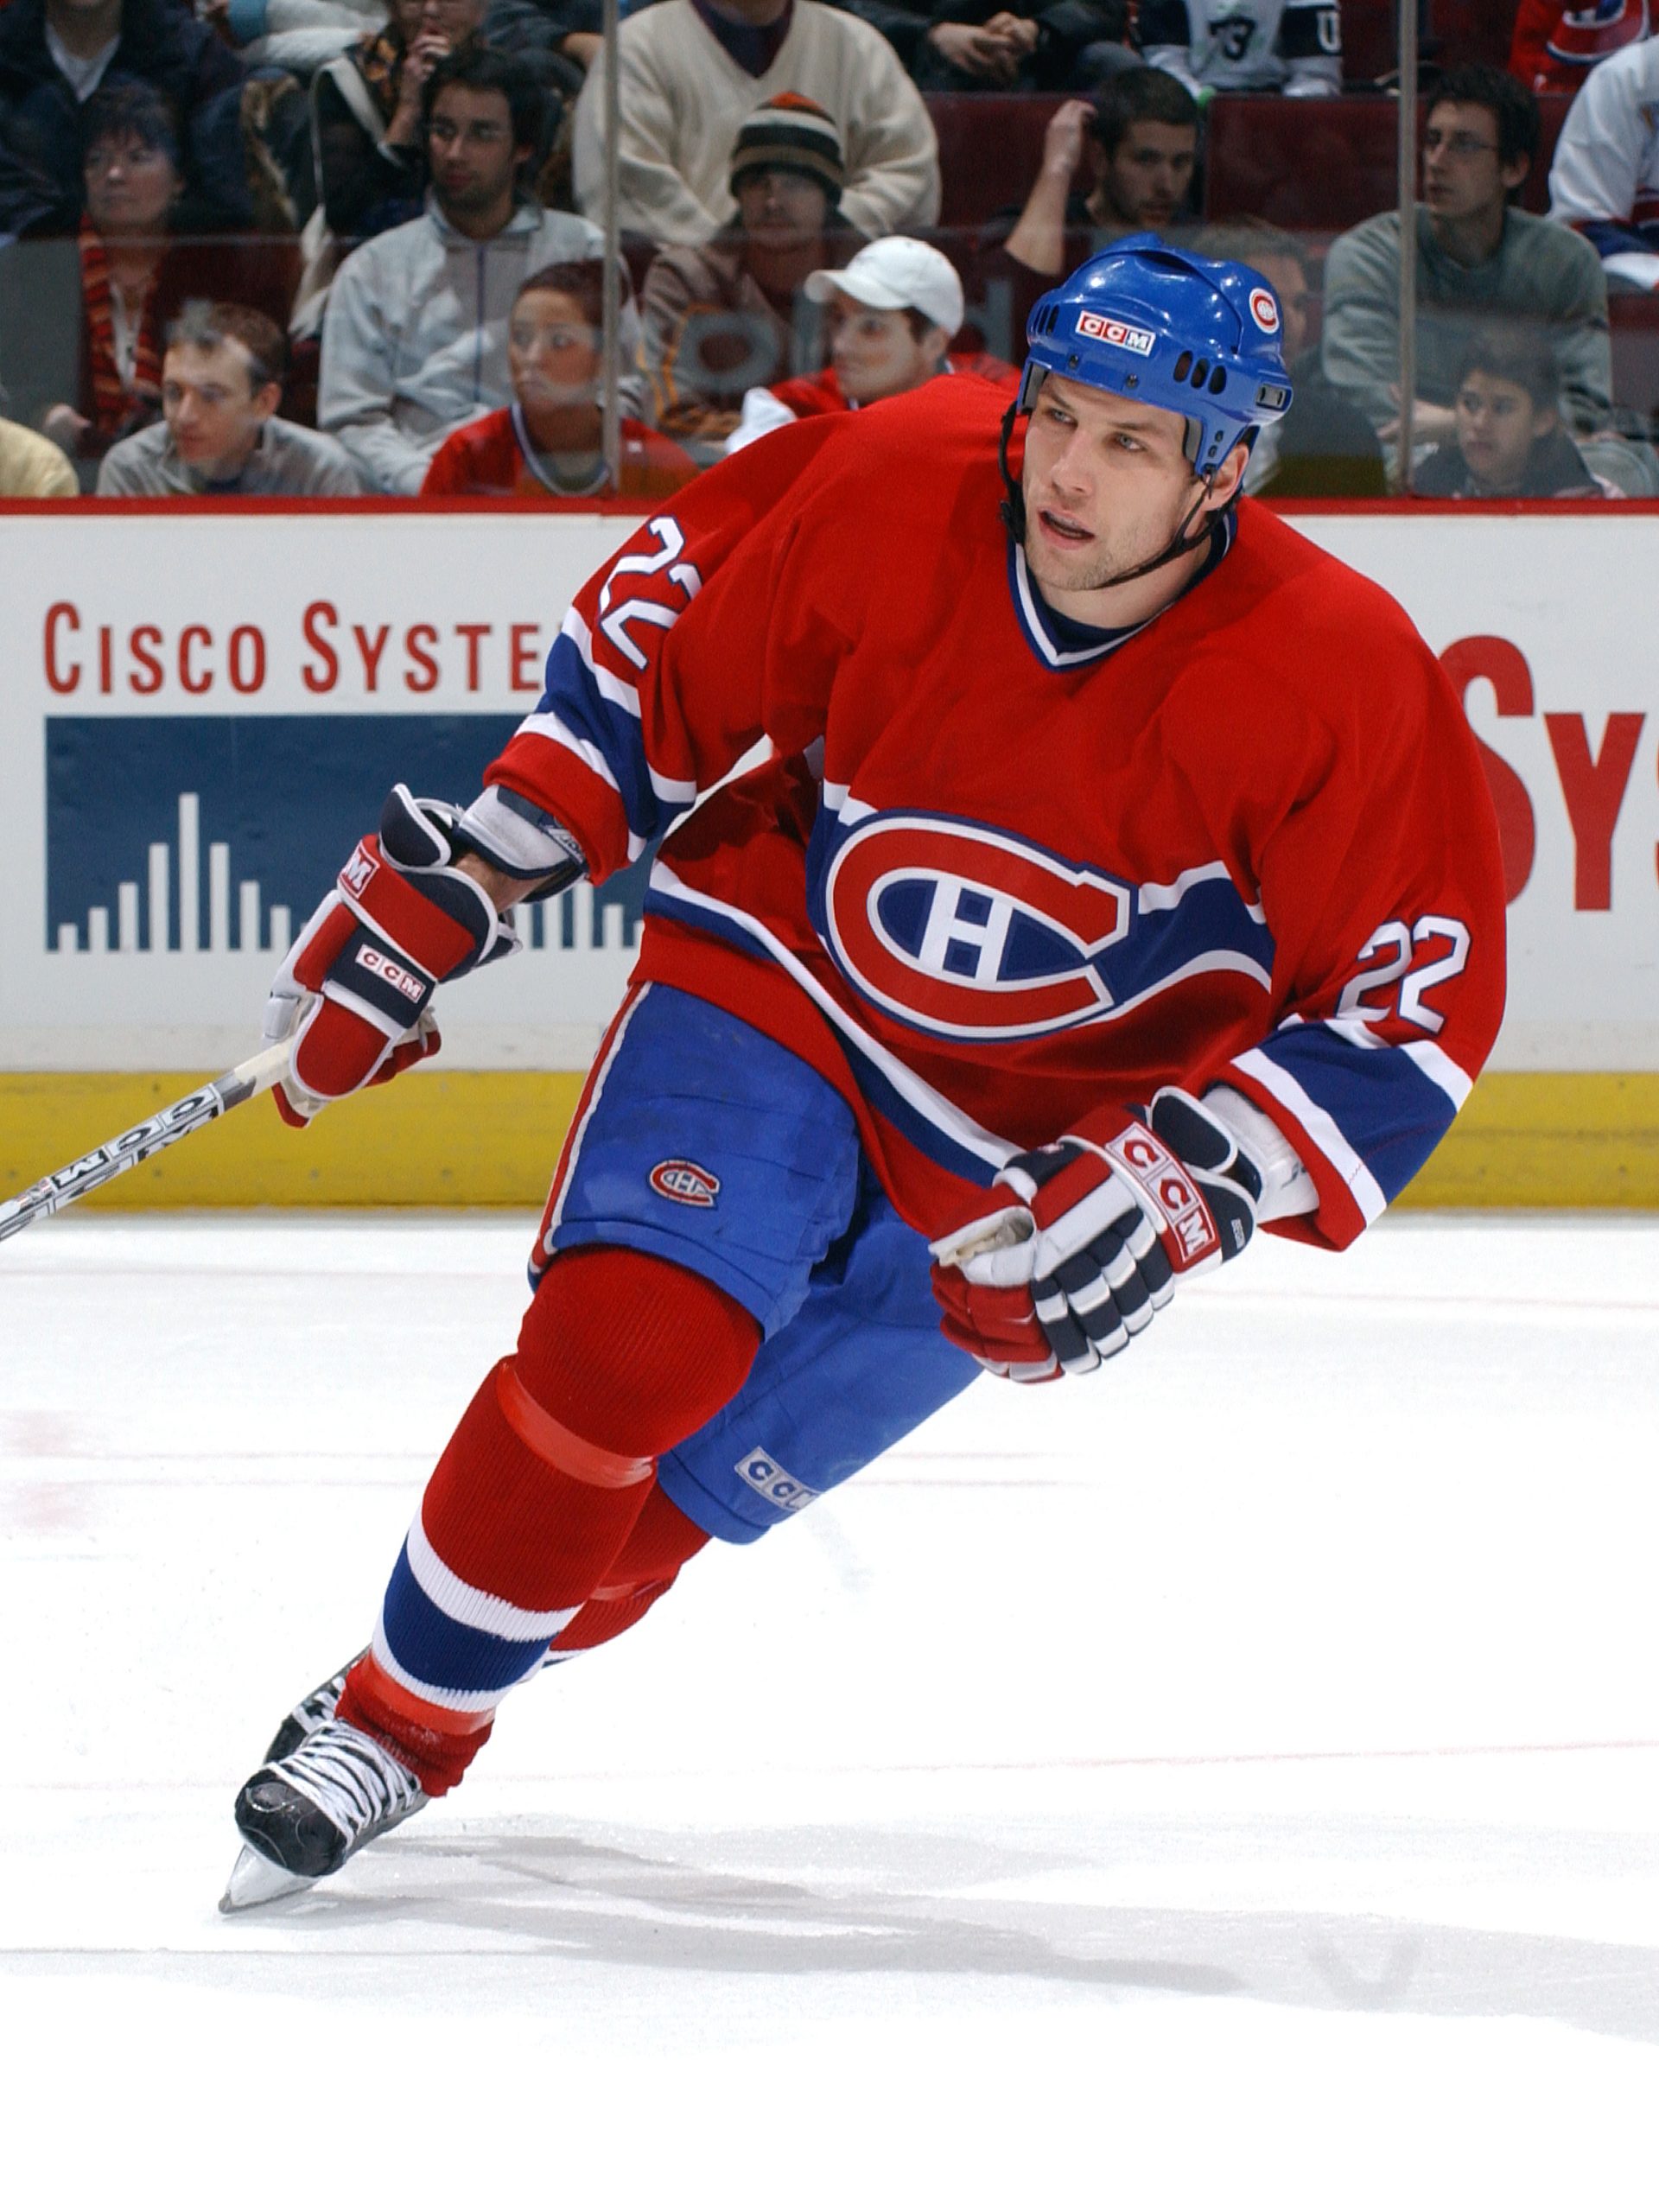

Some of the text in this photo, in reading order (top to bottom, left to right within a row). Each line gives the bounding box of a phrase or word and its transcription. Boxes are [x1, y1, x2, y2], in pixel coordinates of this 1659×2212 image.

[1083, 315, 1151, 351] CCM
[44, 601, 563, 694] CISCO SYSTE
[600, 516, 703, 672] 22
[1438, 635, 1659, 912] SY
[363, 951, 422, 997] CCM
[1336, 914, 1471, 1033] 22
[1122, 1139, 1210, 1255] CCM
